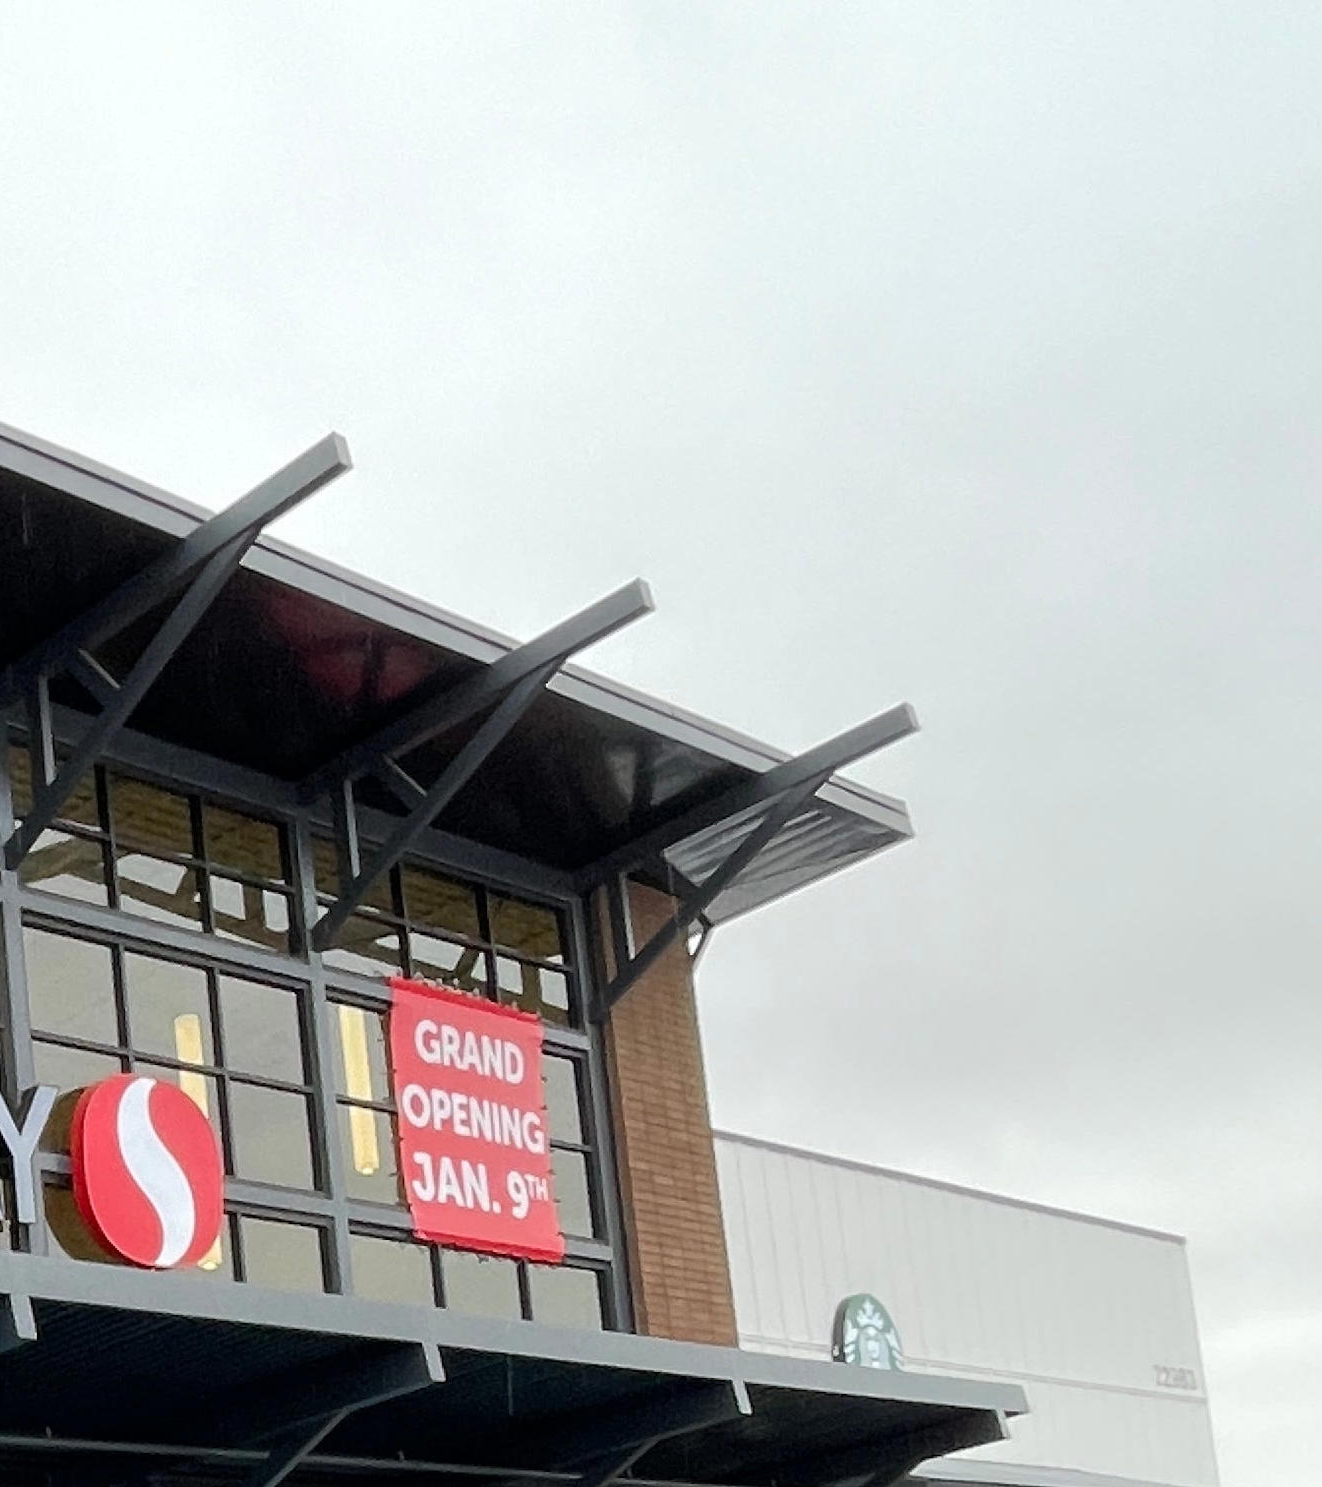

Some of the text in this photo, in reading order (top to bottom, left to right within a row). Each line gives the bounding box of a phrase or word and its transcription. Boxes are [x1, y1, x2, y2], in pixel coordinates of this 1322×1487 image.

[413, 1018, 525, 1085] GRAND
[401, 1083, 545, 1154] OPENING
[412, 1151, 549, 1219] JAN. 9TH
